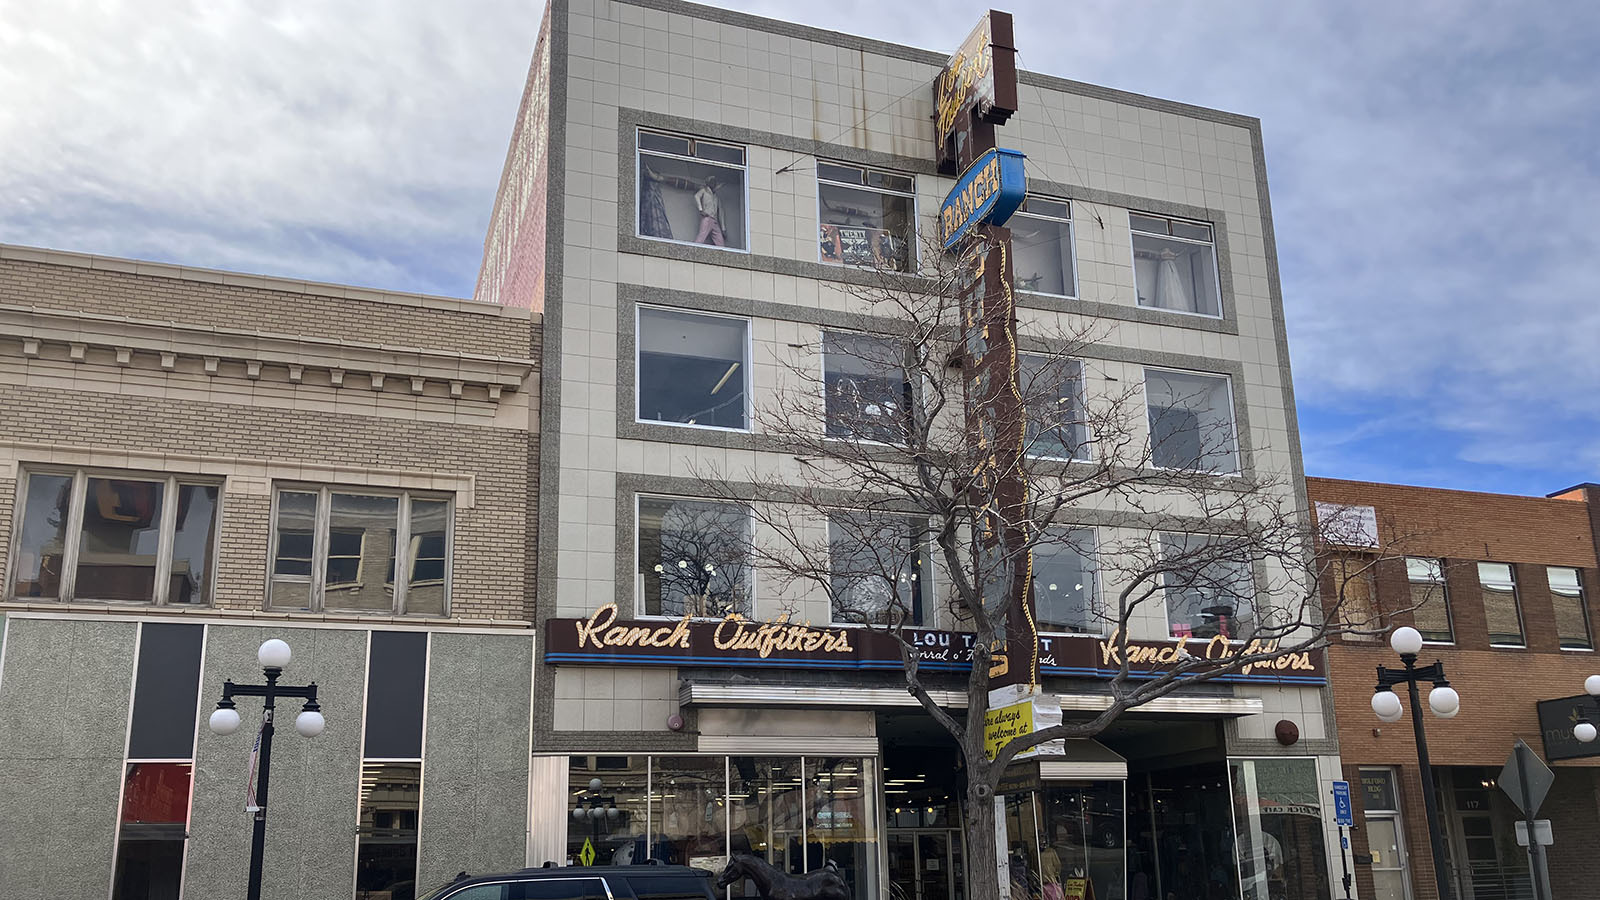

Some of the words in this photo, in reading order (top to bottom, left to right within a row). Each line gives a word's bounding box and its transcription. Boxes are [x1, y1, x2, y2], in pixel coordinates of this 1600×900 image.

[943, 157, 998, 241] RANCH
[575, 602, 691, 649] Ranch
[713, 612, 854, 659] Outfitters
[913, 632, 950, 647] LOU
[994, 710, 1021, 727] always
[988, 726, 1017, 741] welcome
[1019, 722, 1028, 735] at
[1466, 800, 1480, 809] 117
